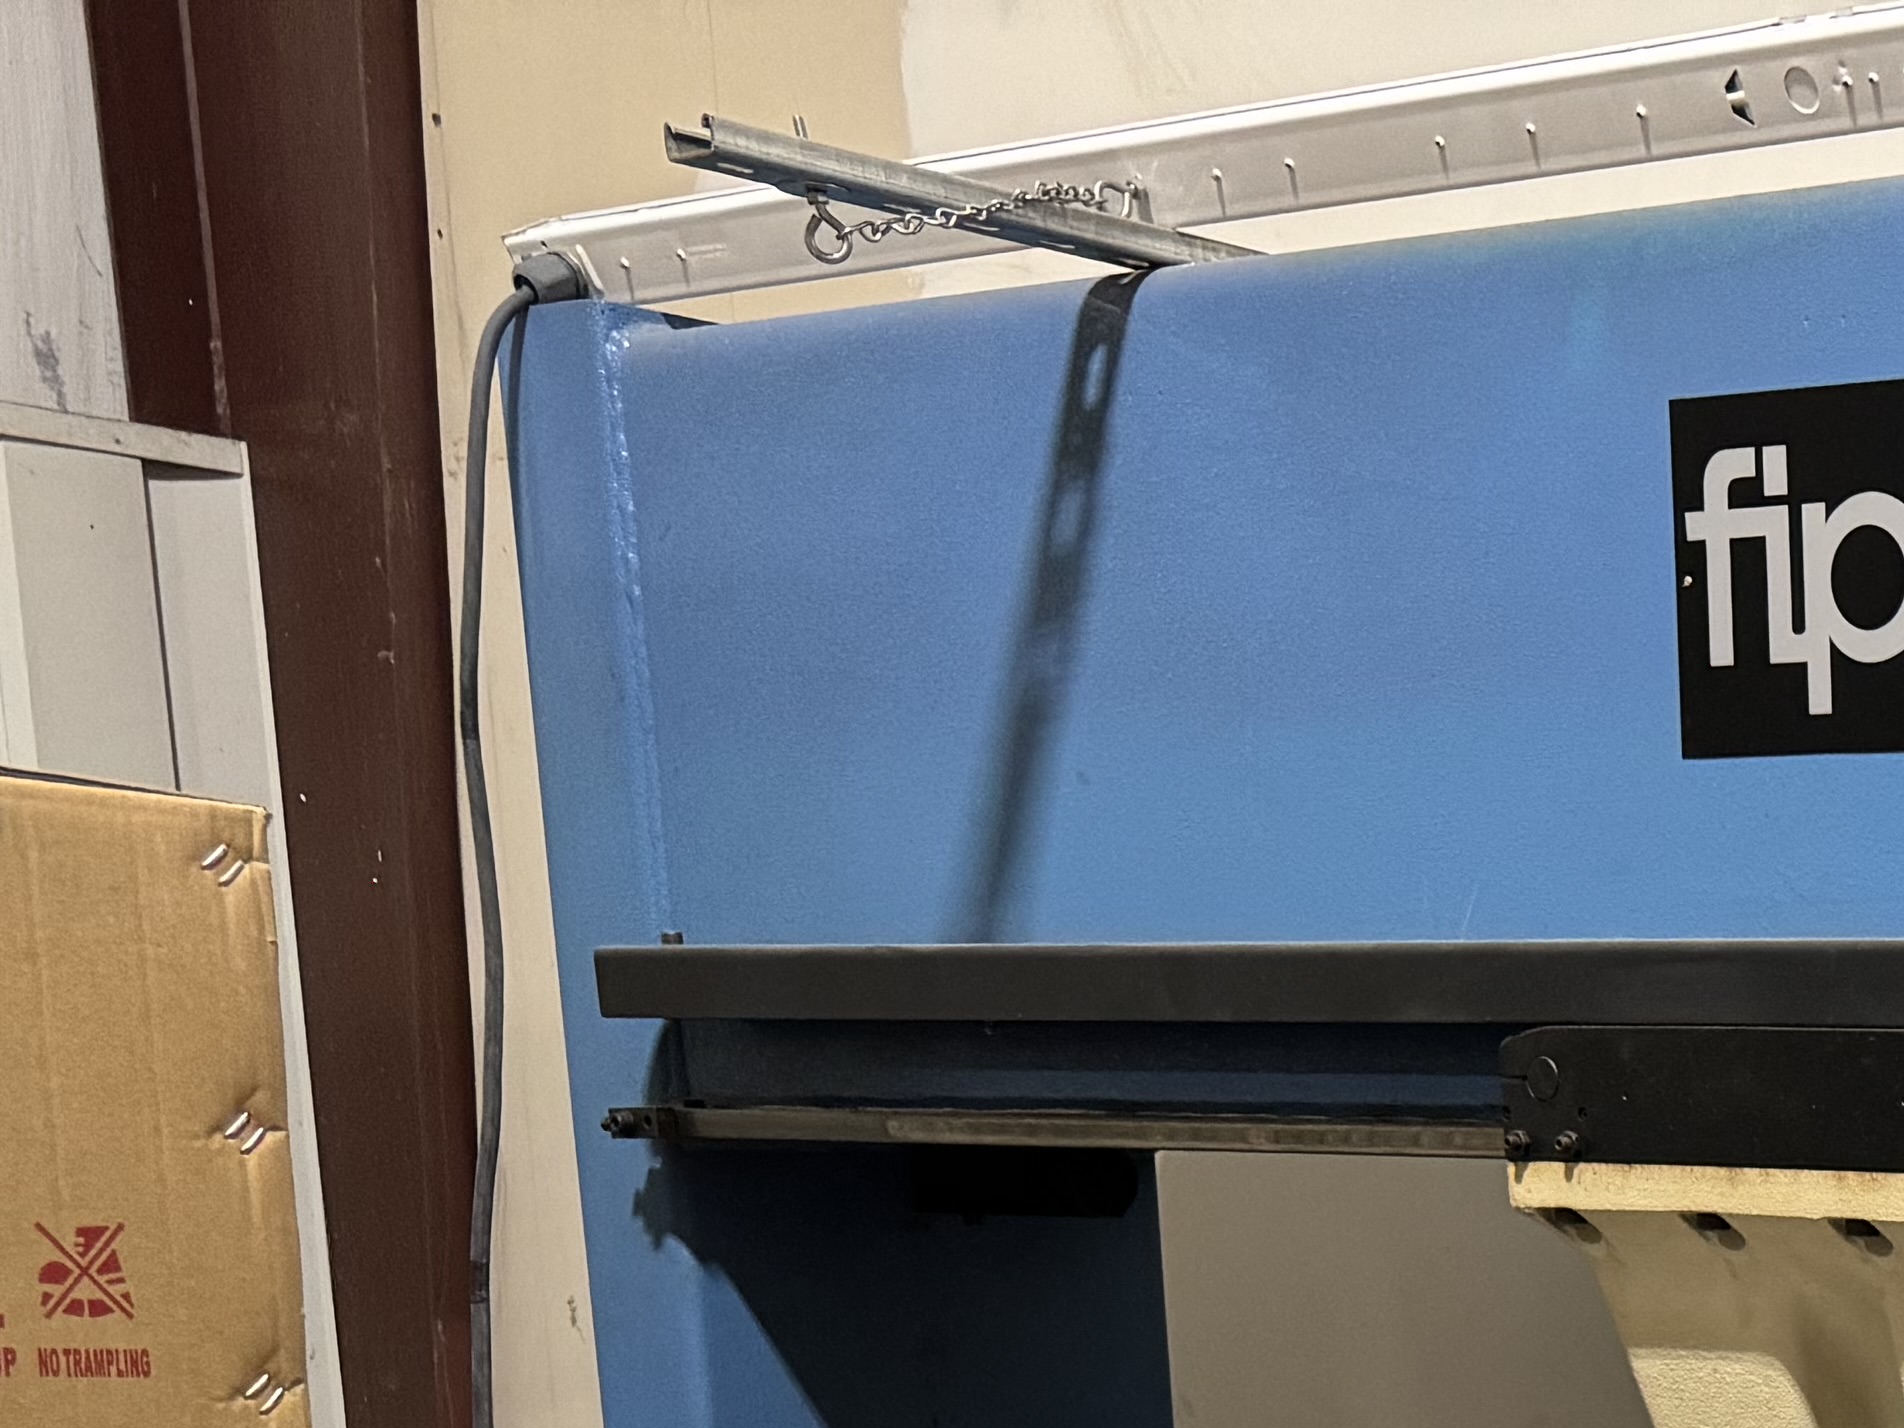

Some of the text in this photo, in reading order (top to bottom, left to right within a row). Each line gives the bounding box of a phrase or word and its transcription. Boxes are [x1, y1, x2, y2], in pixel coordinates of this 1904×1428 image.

[0, 1347, 17, 1377] P
[38, 1347, 151, 1378] NO TRAMPLING
